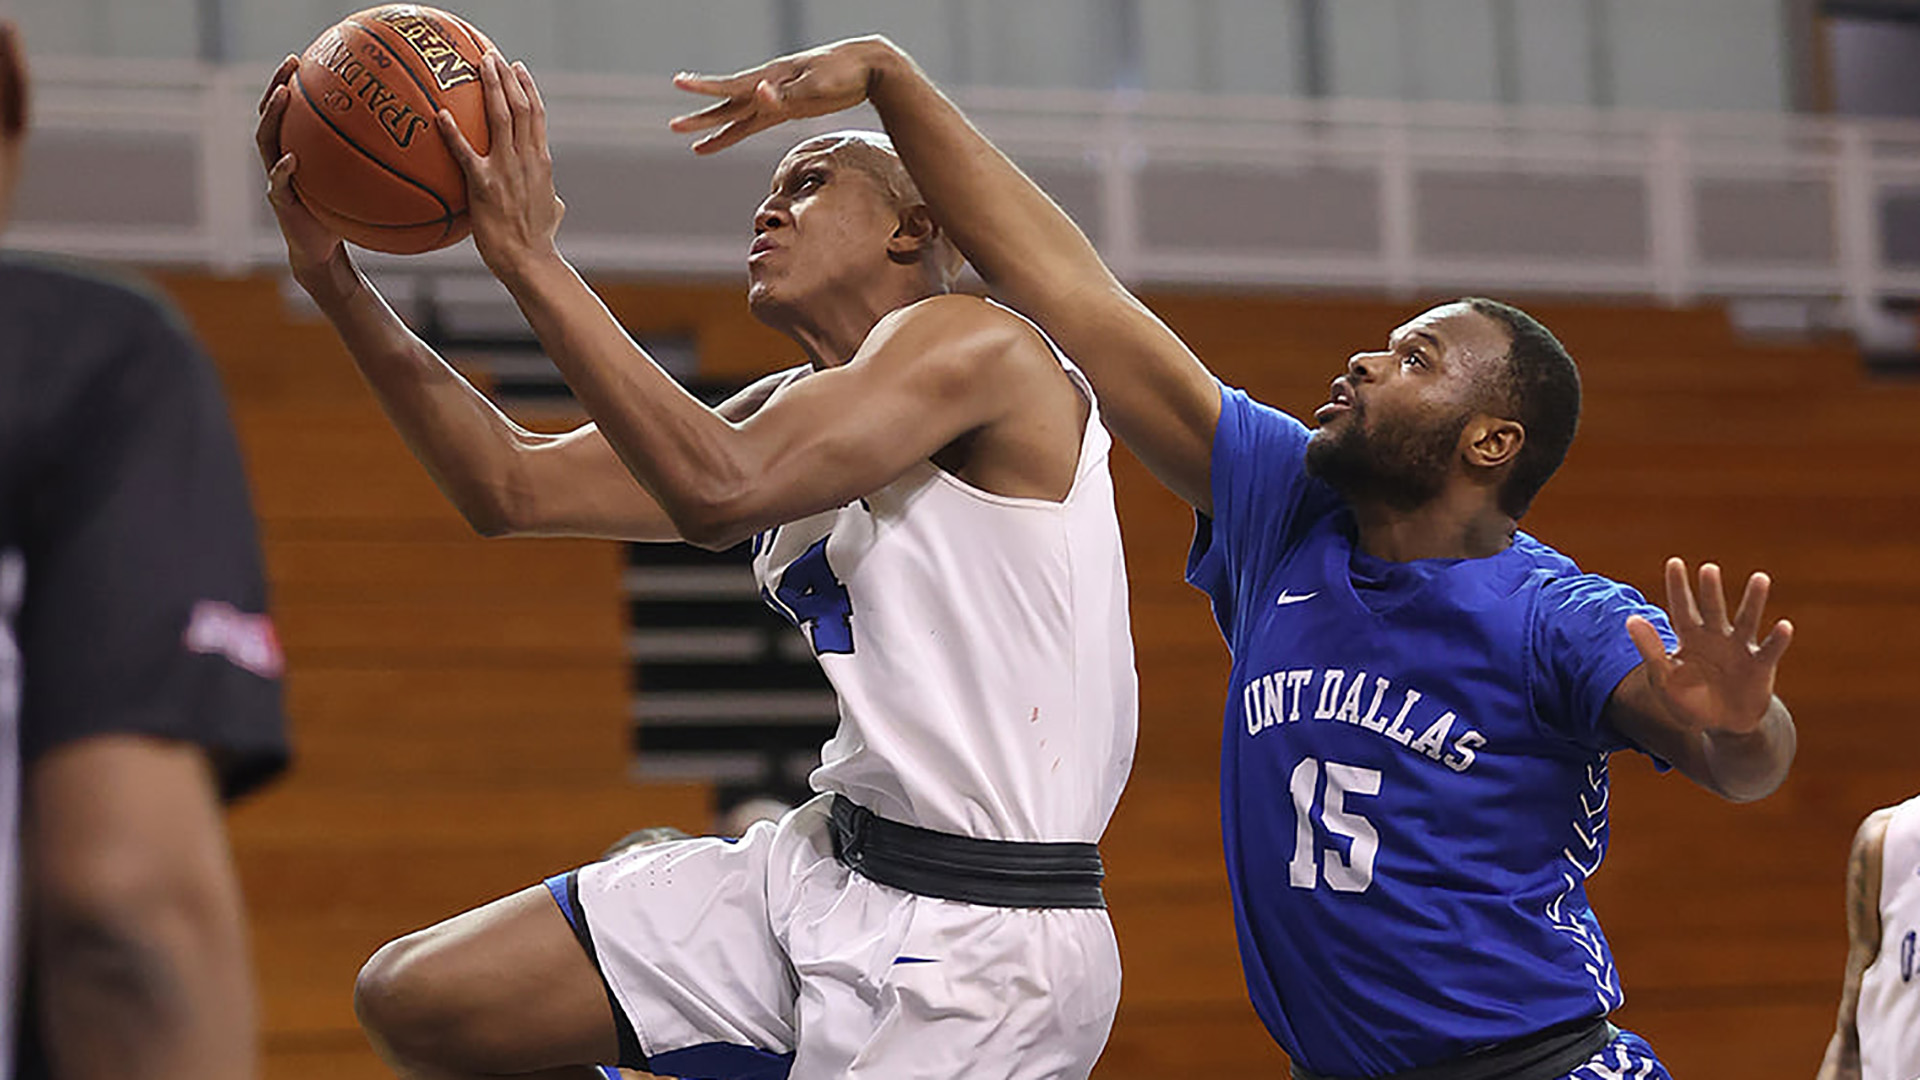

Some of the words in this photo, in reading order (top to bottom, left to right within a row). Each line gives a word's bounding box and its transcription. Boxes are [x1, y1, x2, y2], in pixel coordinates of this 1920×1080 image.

[761, 533, 855, 656] 4
[1244, 669, 1313, 736] UNT
[1314, 669, 1487, 772] DALLAS
[1289, 757, 1382, 893] 15
